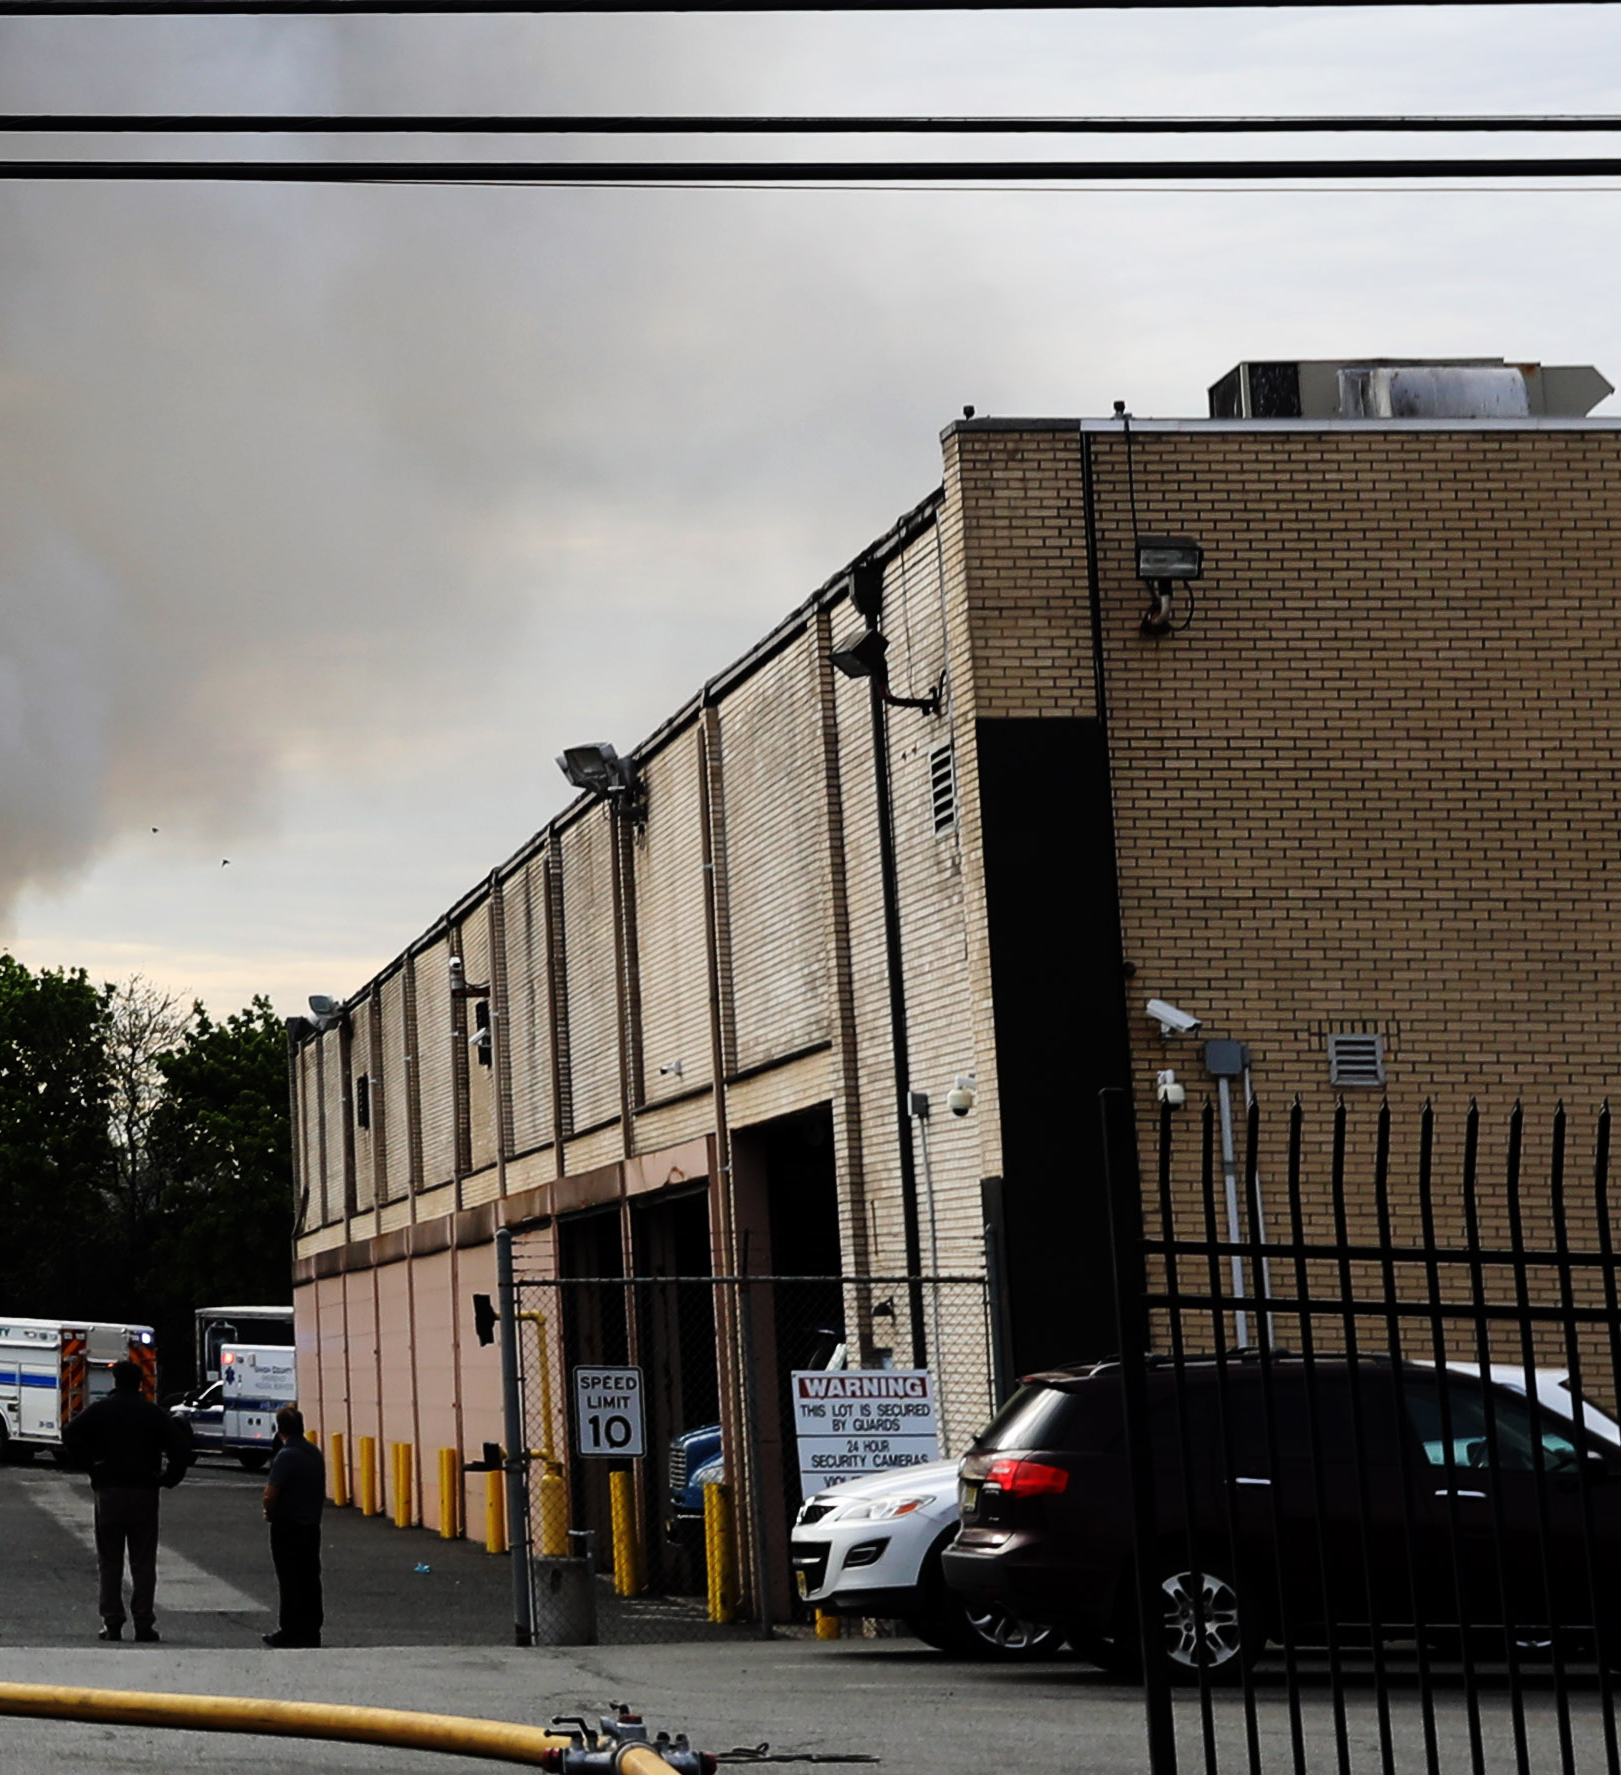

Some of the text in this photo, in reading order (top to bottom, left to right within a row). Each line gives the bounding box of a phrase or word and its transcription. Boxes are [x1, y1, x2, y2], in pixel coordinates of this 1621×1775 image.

[580, 1375, 638, 1391] SPEED
[805, 1378, 924, 1397] WARNING
[586, 1396, 631, 1410] LIMIT
[801, 1404, 931, 1418] THIS LOT IS SECURED
[588, 1414, 632, 1449] 10
[832, 1419, 901, 1432] BY GUARDS
[847, 1440, 890, 1453] 24 HOUR
[812, 1454, 929, 1469] SECURITY CAMERAS
